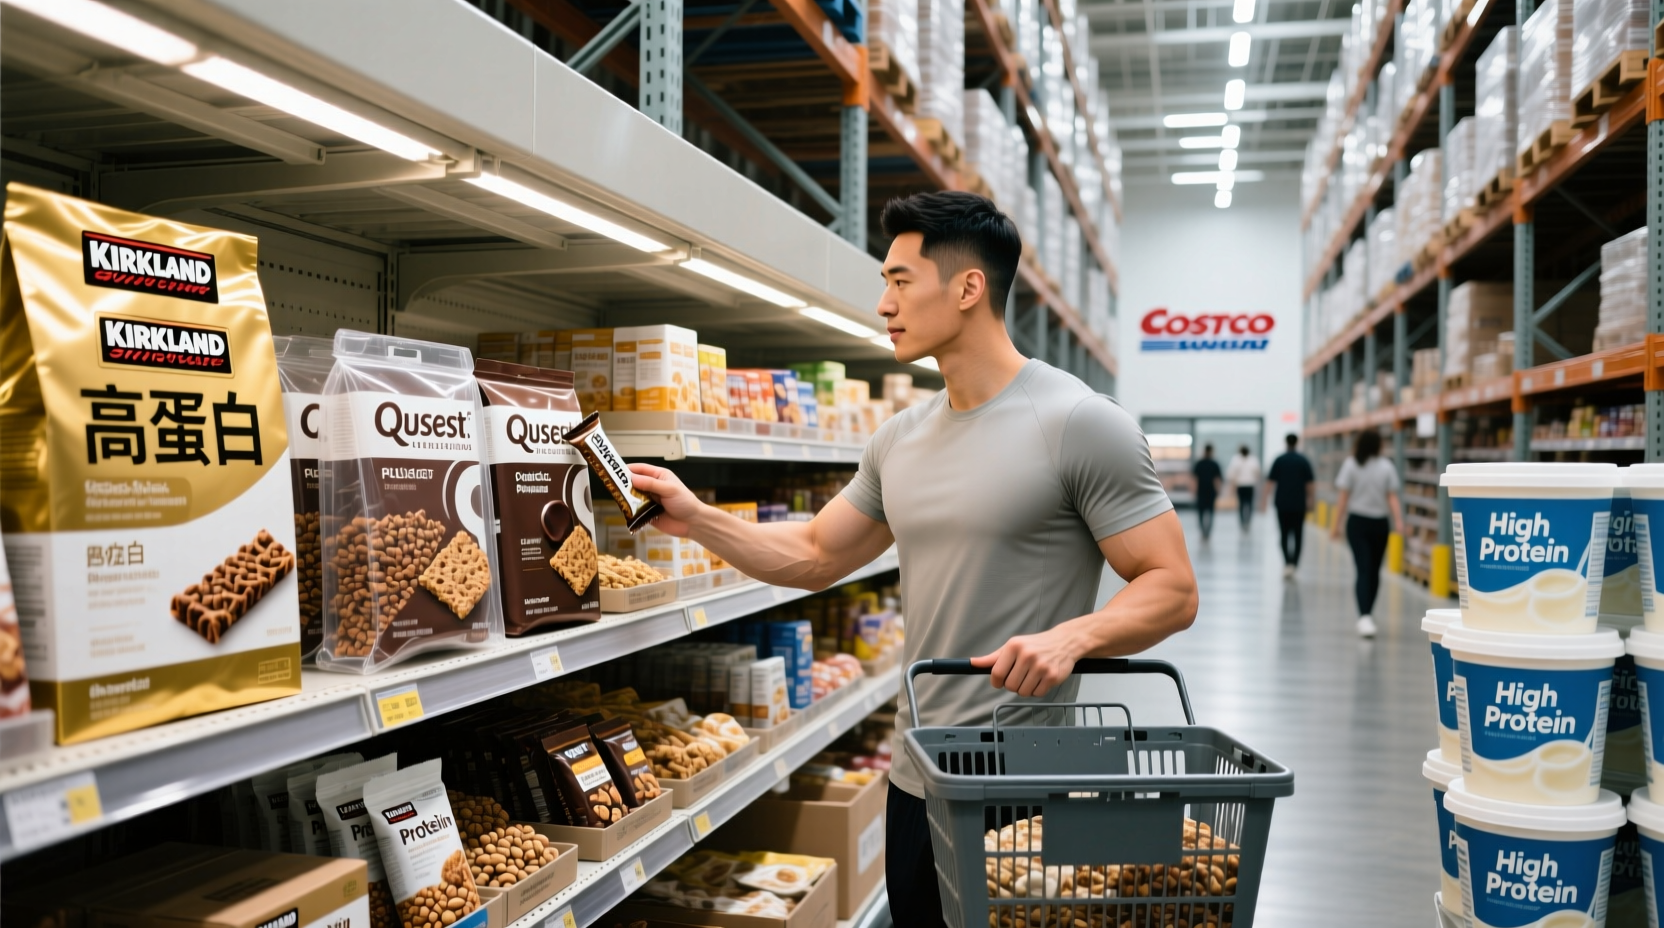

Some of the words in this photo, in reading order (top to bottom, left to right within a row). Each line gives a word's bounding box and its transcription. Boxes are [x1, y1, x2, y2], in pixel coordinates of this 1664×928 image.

[89, 240, 212, 284] KIRKLAND
[105, 320, 225, 356] KIRKLAND
[80, 384, 263, 467] 高蛋白
[1489, 511, 1550, 543] High
[1480, 536, 1569, 563] Protein
[1495, 681, 1558, 712] High
[1484, 705, 1576, 734] Protein
[1496, 849, 1558, 883] High
[1486, 871, 1578, 904] Protein
